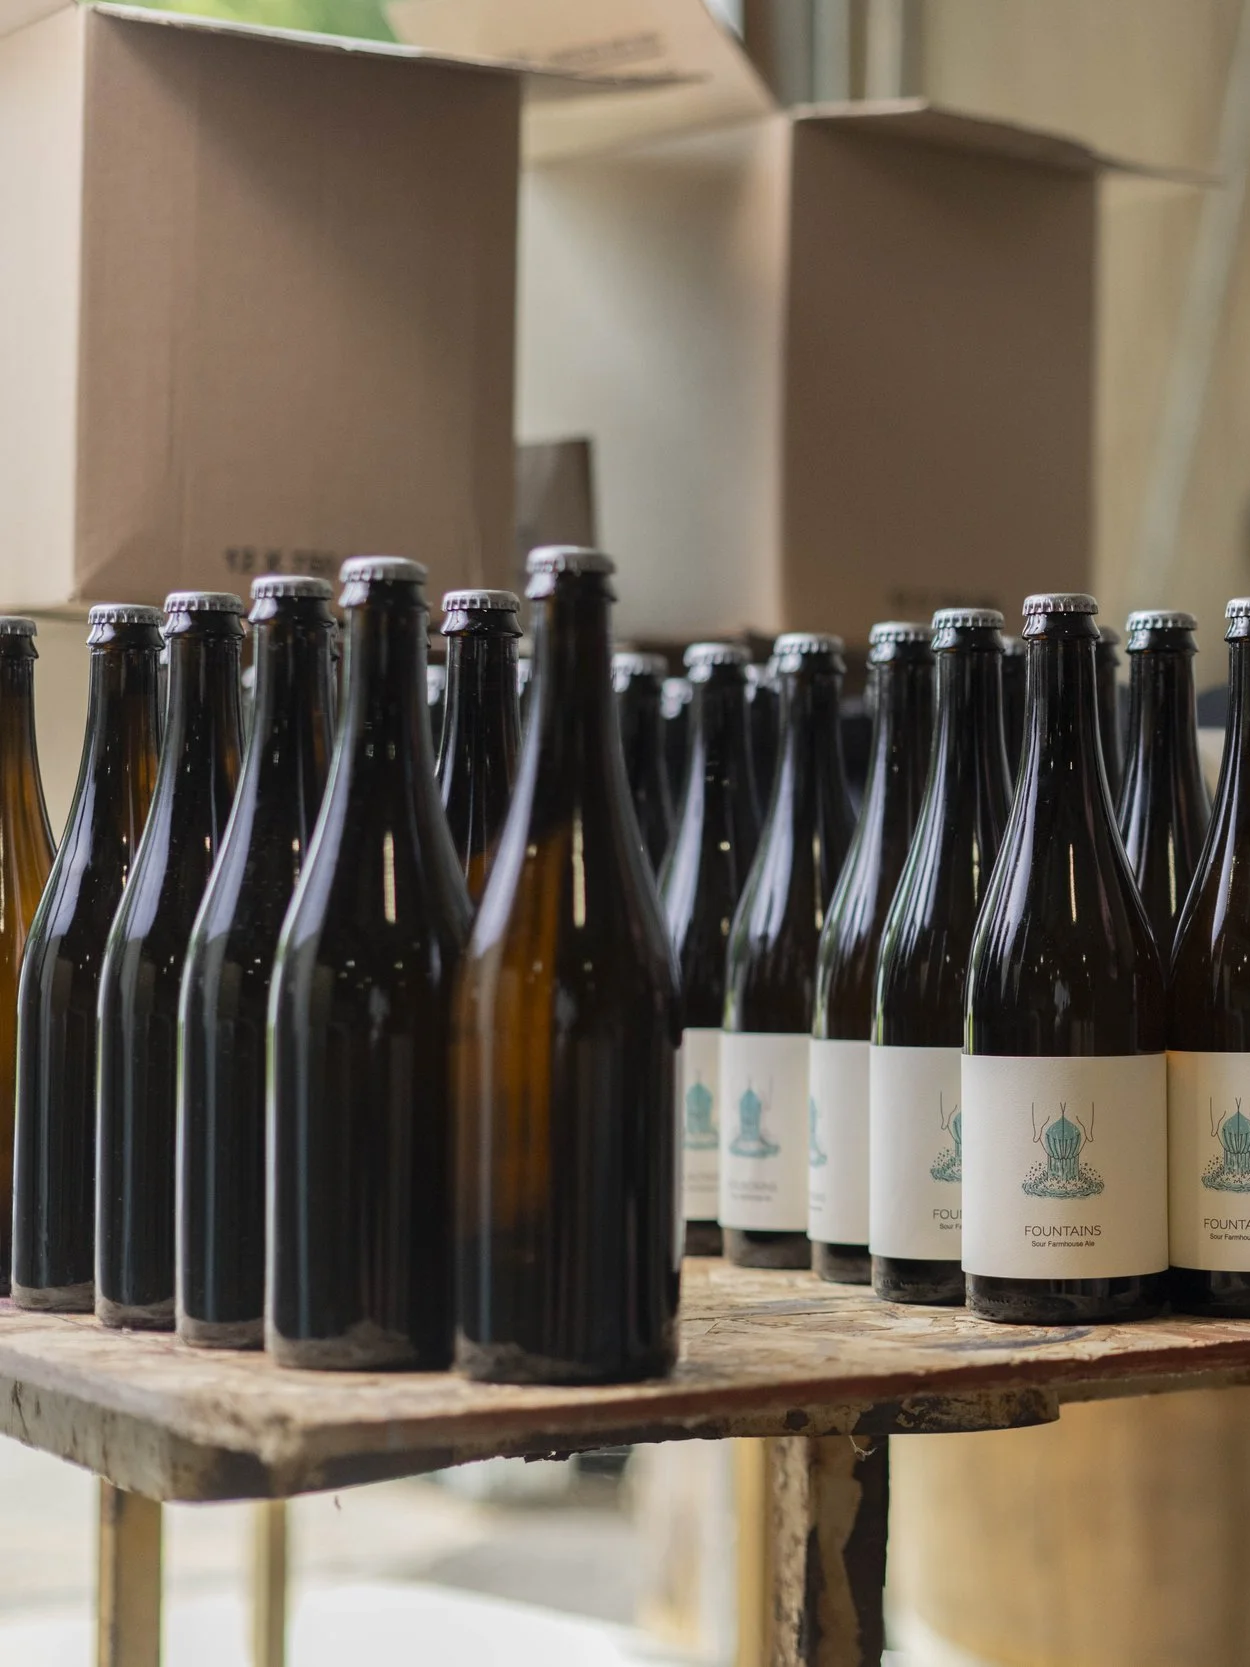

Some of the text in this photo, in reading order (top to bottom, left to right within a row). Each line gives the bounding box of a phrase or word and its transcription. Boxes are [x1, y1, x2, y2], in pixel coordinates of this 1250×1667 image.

[933, 1209, 962, 1220] FOU
[1024, 1225, 1102, 1237] FOUNTAINS
[1031, 1240, 1046, 1248] Sour
[1048, 1240, 1084, 1248] Farmhouse
